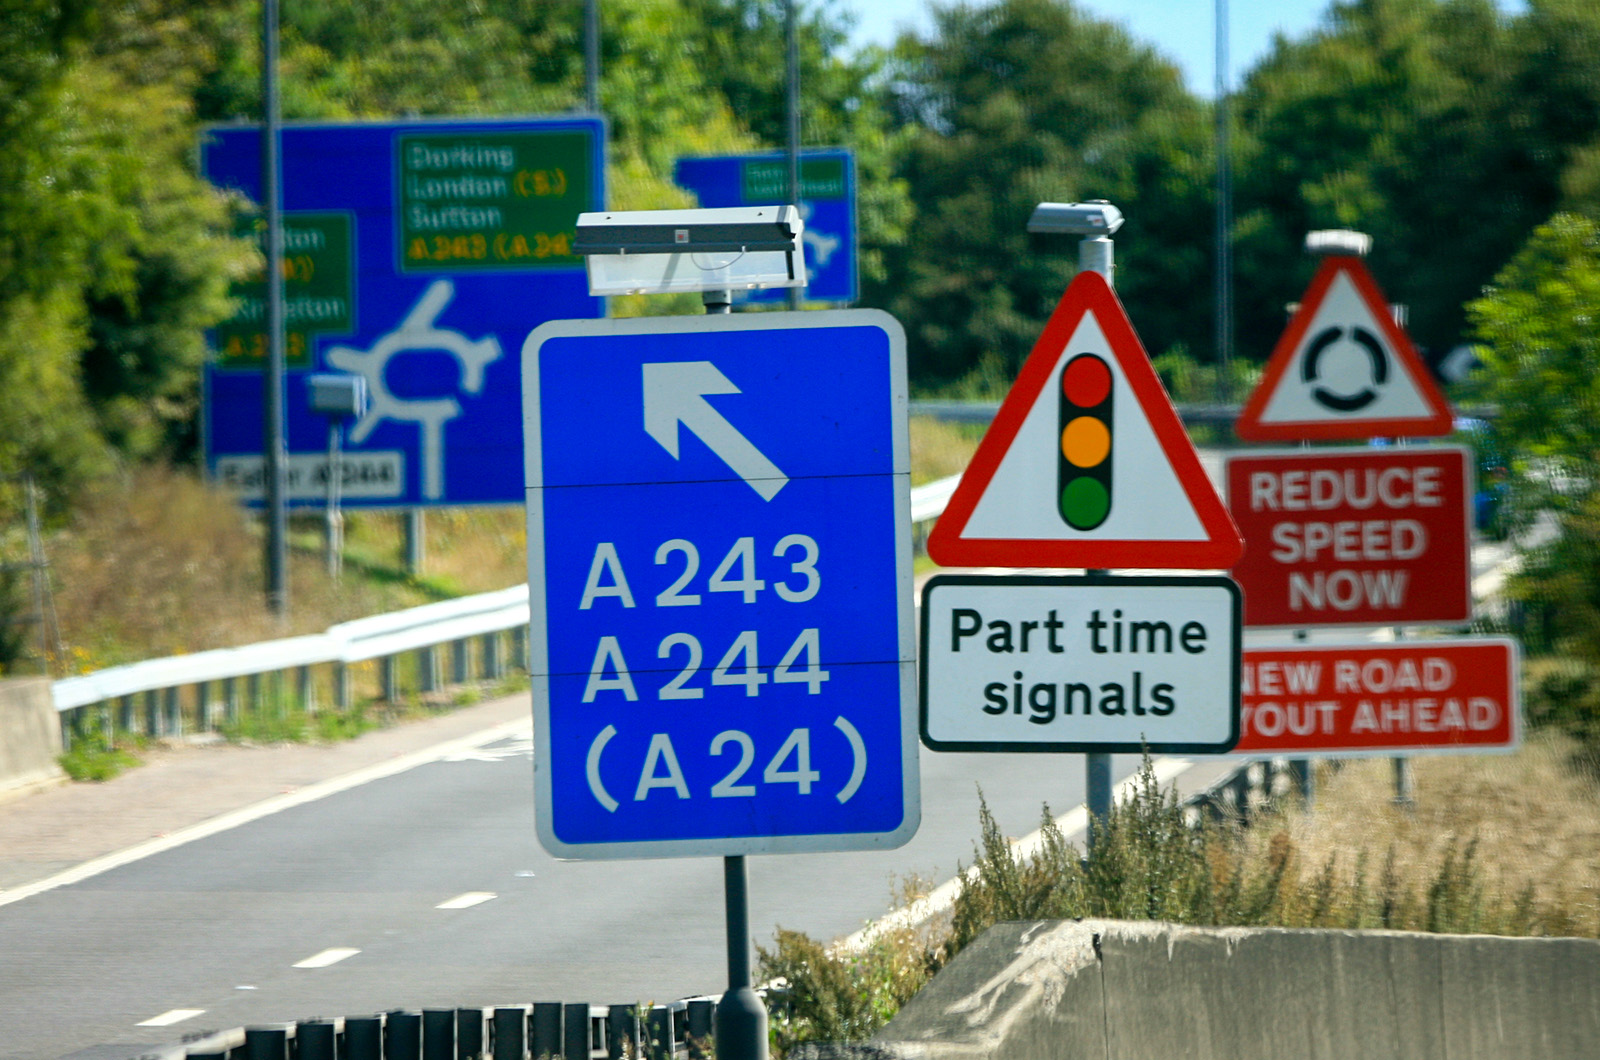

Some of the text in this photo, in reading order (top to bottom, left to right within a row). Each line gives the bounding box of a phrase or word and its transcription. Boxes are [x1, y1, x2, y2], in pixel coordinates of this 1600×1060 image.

[407, 174, 507, 199] London
[408, 203, 502, 231] Sutton
[1250, 466, 1443, 511] REDUCE
[1271, 518, 1427, 563] SPEED
[1288, 569, 1410, 611] NOW
[951, 608, 1207, 654] Part time
[1335, 656, 1457, 694] ROAD
[981, 670, 1176, 725] signals
[1350, 696, 1504, 735] AHEAD
